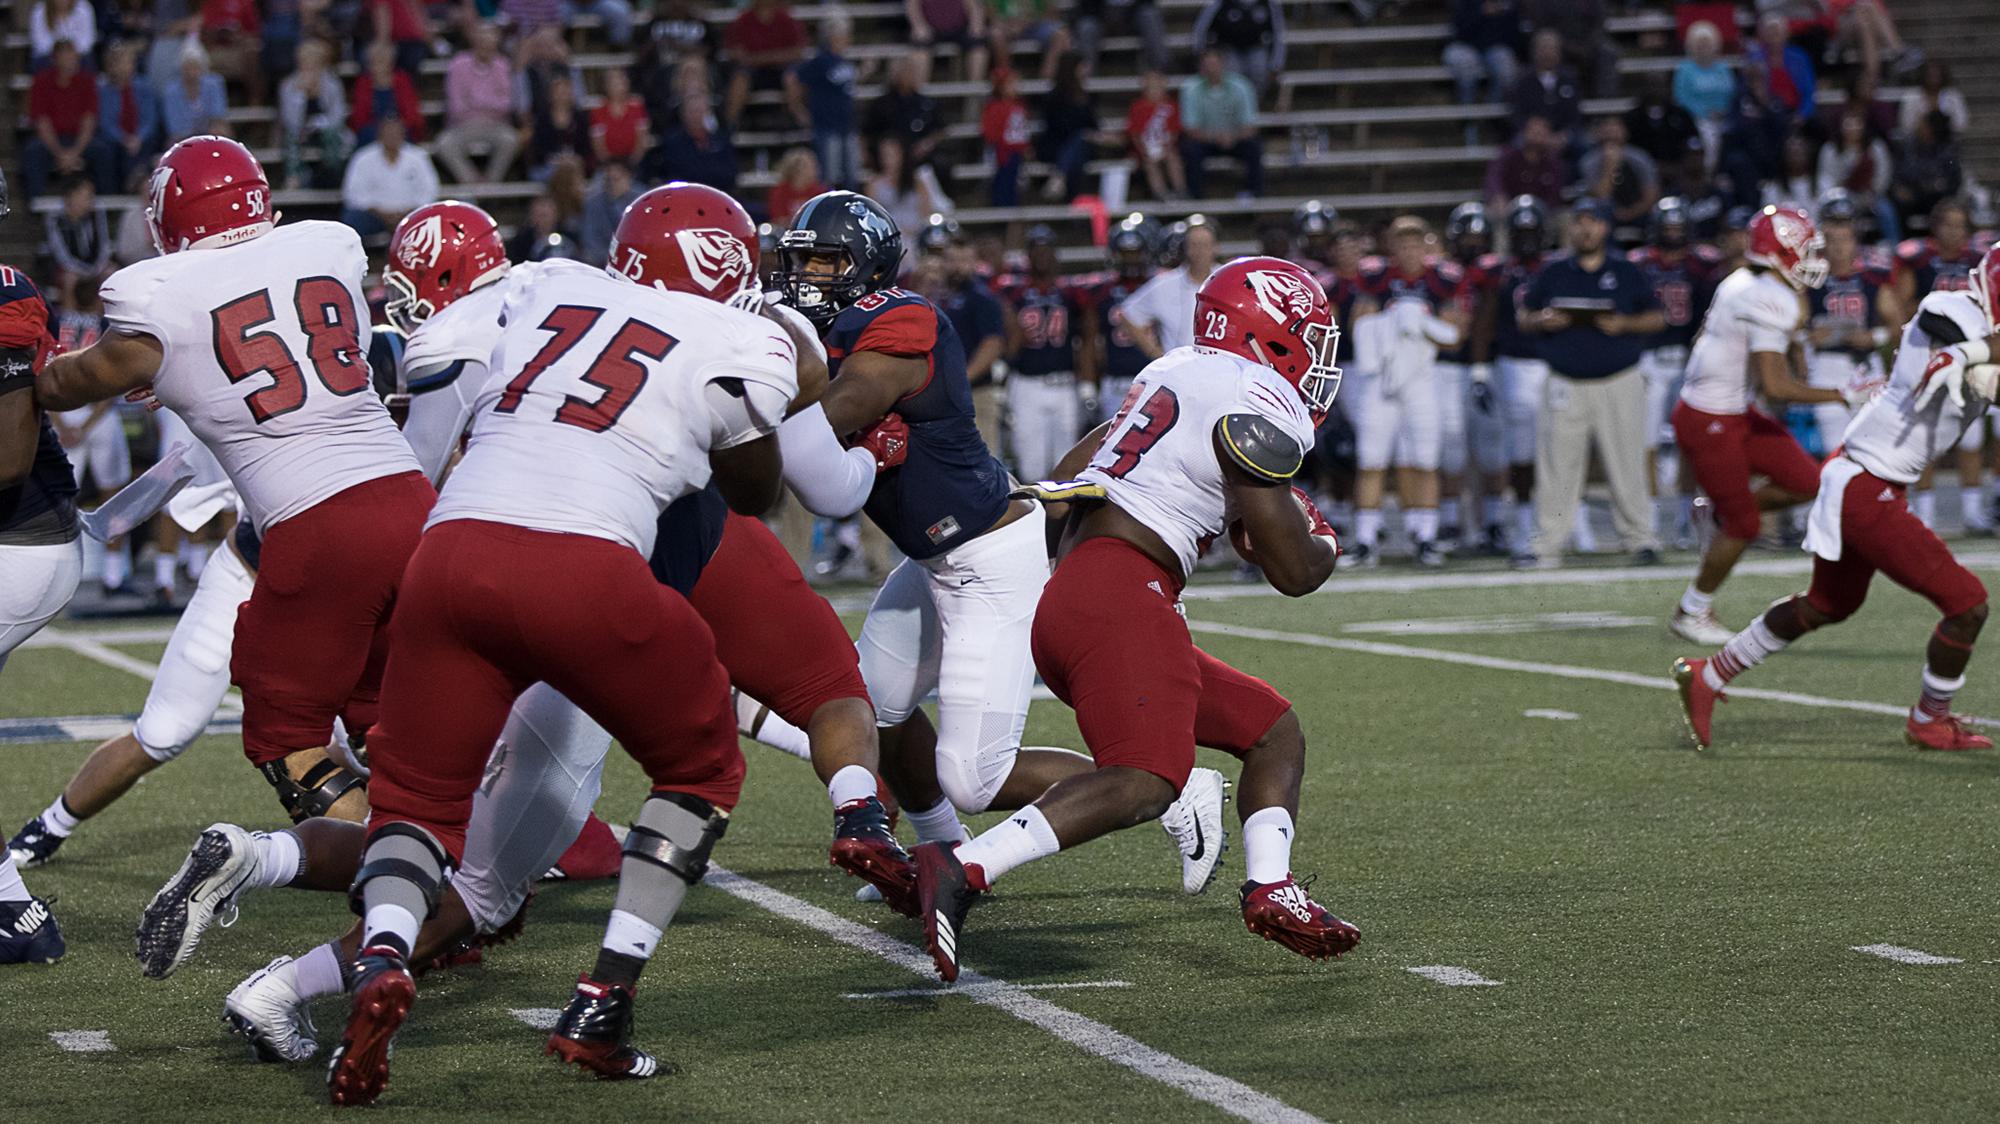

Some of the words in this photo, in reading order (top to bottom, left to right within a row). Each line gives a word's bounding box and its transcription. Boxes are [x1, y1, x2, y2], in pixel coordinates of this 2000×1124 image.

[246, 189, 264, 217] 58
[622, 247, 647, 280] 75
[1205, 311, 1227, 340] 23
[210, 276, 370, 425] 58
[493, 305, 680, 433] 75
[14, 901, 48, 934] NIKE
[1267, 893, 1312, 923] adidas
